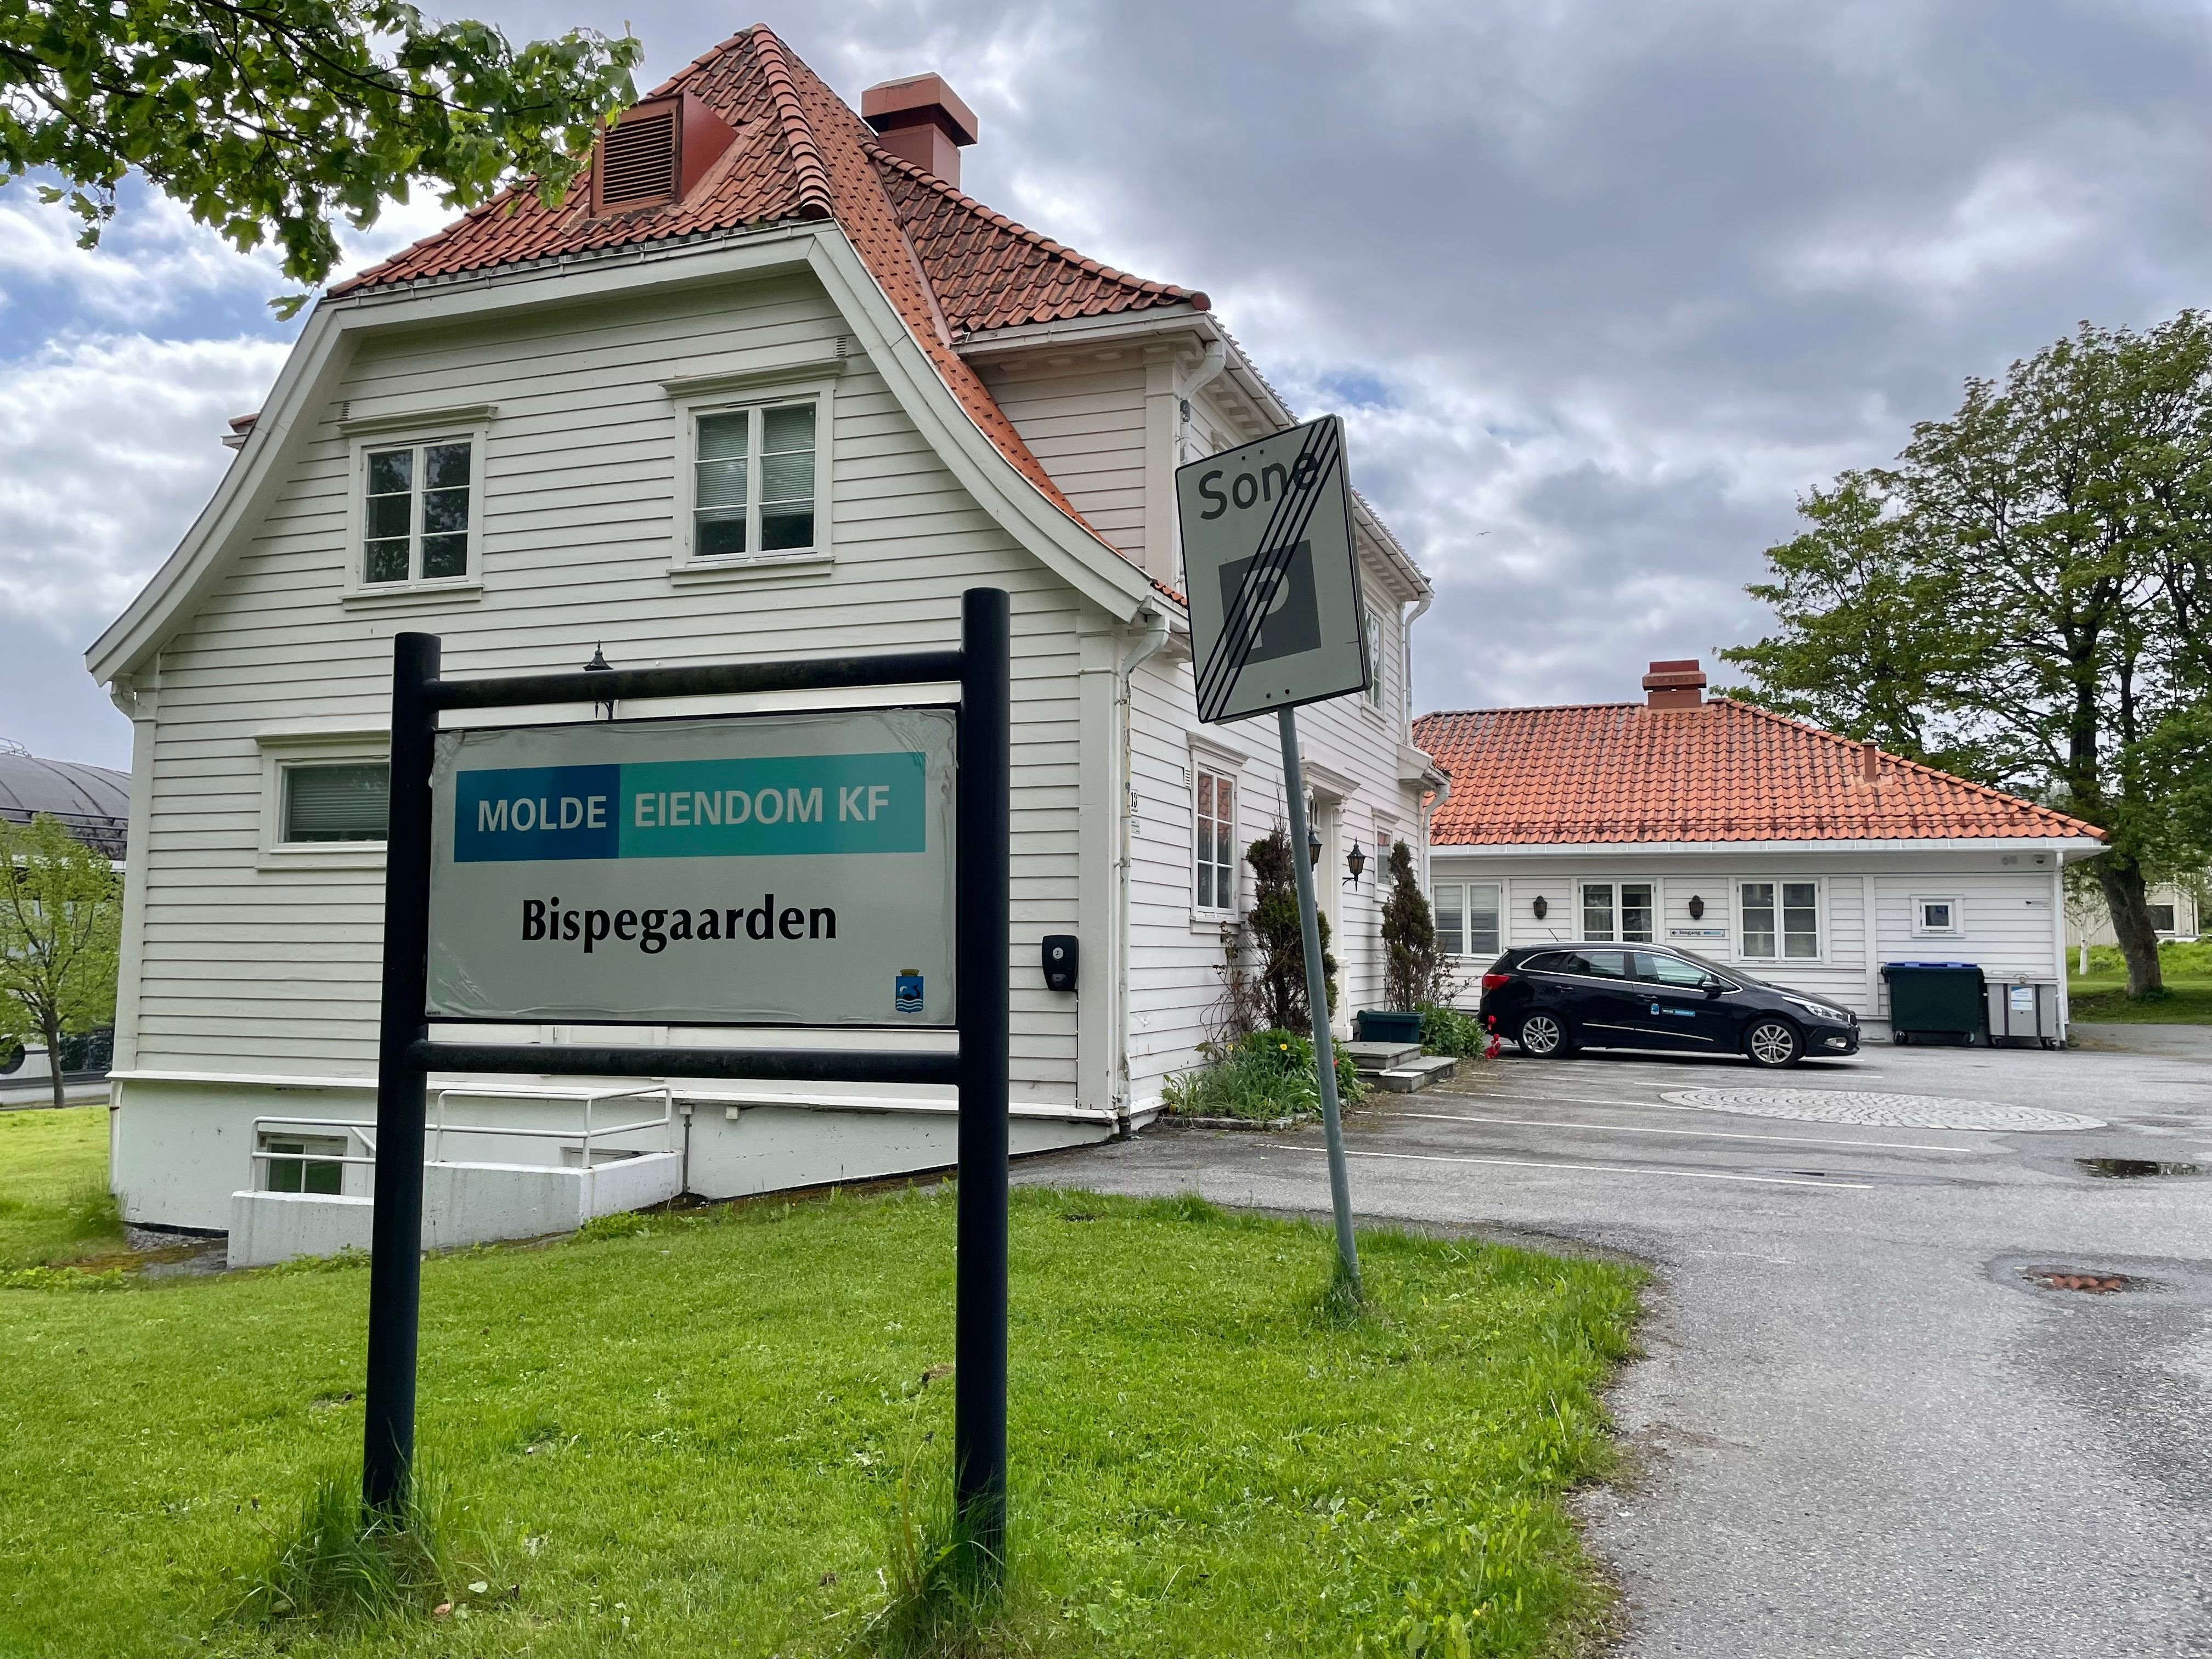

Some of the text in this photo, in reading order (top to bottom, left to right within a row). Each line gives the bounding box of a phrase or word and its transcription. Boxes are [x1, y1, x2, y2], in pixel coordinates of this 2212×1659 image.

[1198, 452, 1318, 520] Sone
[1243, 566, 1289, 650] P
[477, 785, 890, 832] MOLDE EIENDOM KF
[1131, 792, 1137, 808] 13
[521, 893, 837, 955] Bispegaarden
